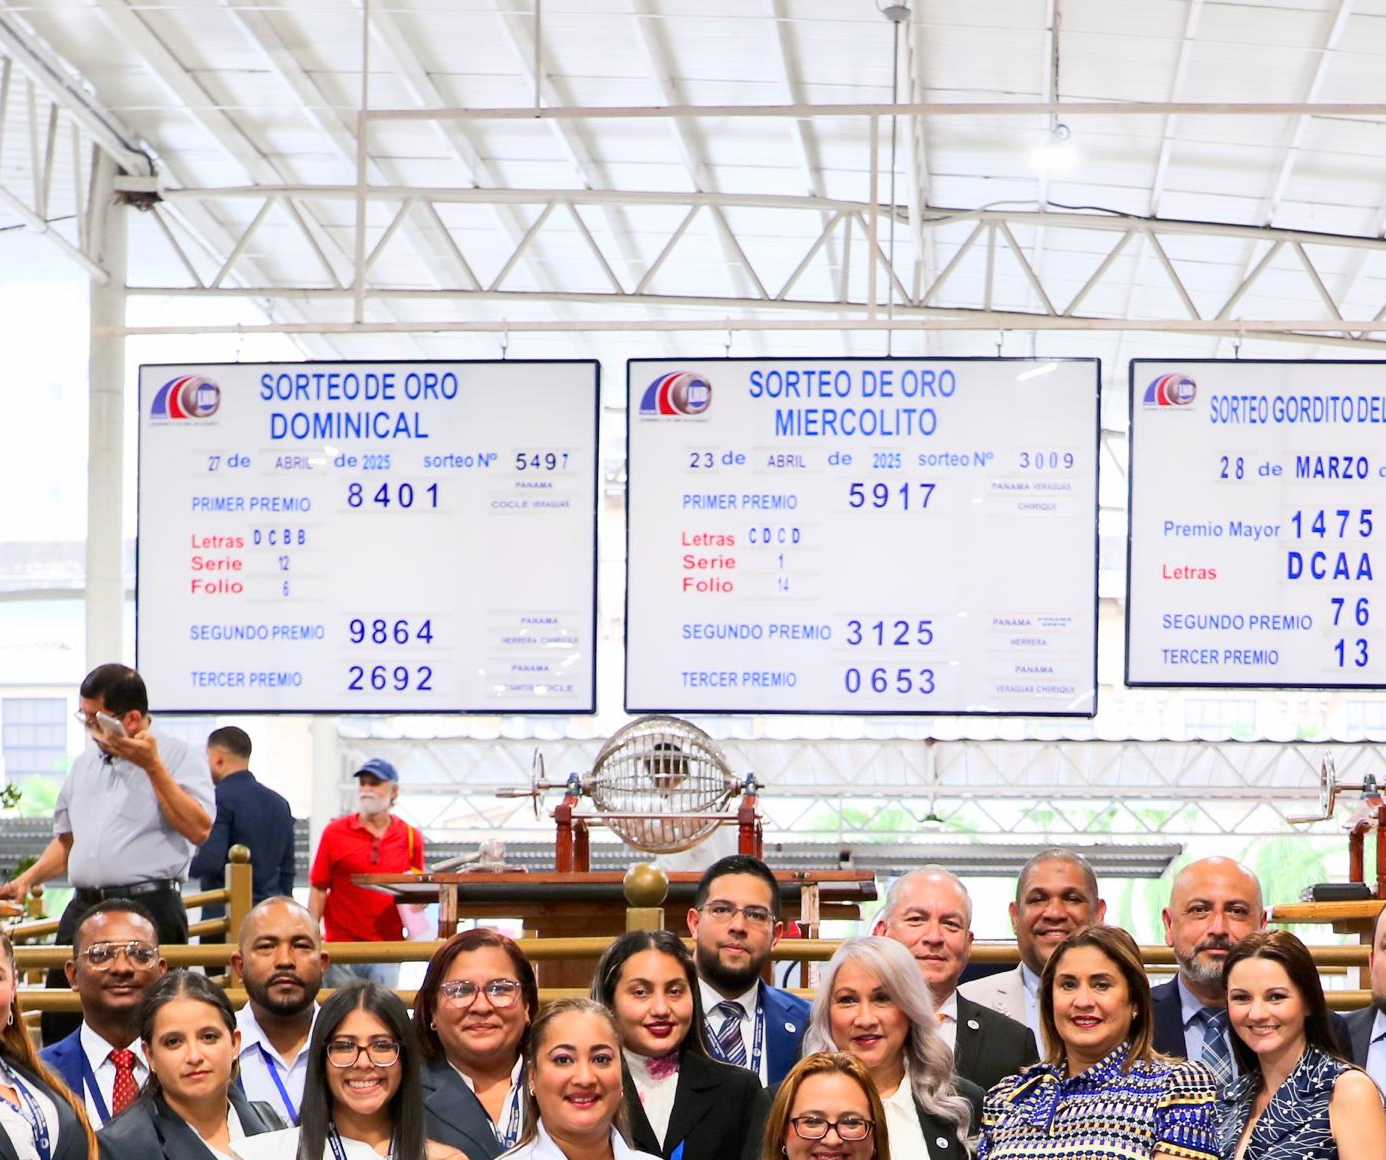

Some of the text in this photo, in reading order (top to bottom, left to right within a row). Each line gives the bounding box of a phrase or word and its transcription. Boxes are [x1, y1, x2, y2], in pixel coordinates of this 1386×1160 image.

[261, 372, 457, 400] SORTEO DE ORO
[750, 369, 955, 398] SORTEO DE ORO
[776, 408, 936, 436] MIERCOLITO
[1211, 396, 1268, 424] SORTEO
[1273, 396, 1353, 423] GORDITO
[271, 412, 429, 440] DOMINICAL
[208, 456, 221, 471] 27
[227, 454, 251, 468] de
[334, 454, 357, 468] de
[363, 454, 390, 470] 2025
[424, 454, 474, 468] sorteo
[690, 452, 713, 468] 23
[722, 451, 745, 465] de
[768, 454, 805, 468] ABRIL
[828, 451, 852, 465] de
[873, 453, 901, 469] 2025
[918, 452, 969, 466] sorteo
[1020, 452, 1073, 469] 3009
[1221, 456, 1243, 479] 28
[1258, 462, 1282, 476] de
[1297, 456, 1368, 479] MARZO
[192, 483, 437, 512] PRIMER PREMIO 8401
[683, 483, 936, 510] PRIMER PREMIO 5917
[1164, 509, 1372, 541] Premio Mayor 1475
[192, 534, 244, 548] Letras
[682, 532, 735, 546] Letras
[192, 556, 242, 571] Serie
[683, 554, 735, 569] Serie
[1163, 551, 1373, 580] Letras DCAA
[191, 579, 243, 594] Folio
[683, 577, 733, 592] Folio
[1163, 598, 1369, 630] SEGUNDO PREMIO 76
[191, 619, 433, 644] SEGUNDO PREMIO 9864
[683, 620, 933, 646] SEGUNDO PREMIO 3125
[1162, 639, 1368, 667] TERCER PREMIO 13
[191, 666, 432, 691] TERCER PREMIO 2692
[682, 668, 935, 694] TERCER PREMIO 0653
